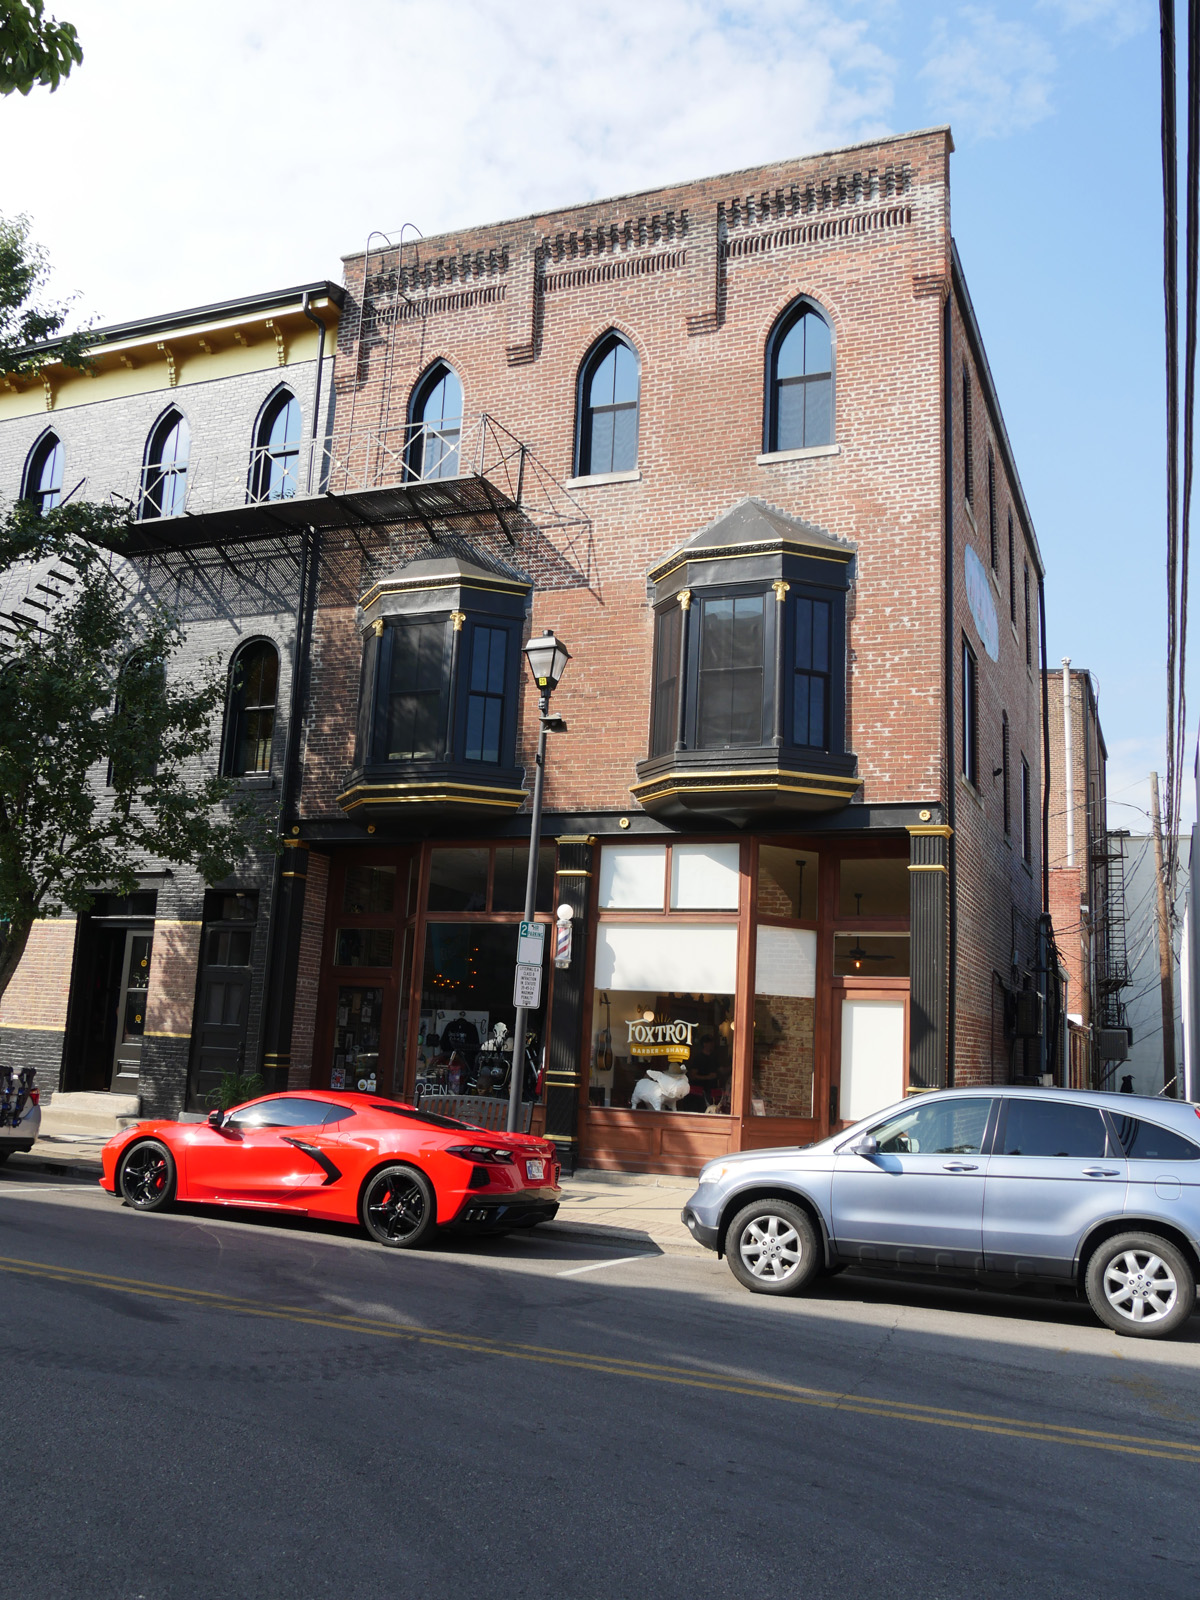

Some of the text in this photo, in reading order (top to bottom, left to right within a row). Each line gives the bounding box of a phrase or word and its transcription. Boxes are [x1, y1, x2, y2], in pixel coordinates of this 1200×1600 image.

[521, 924, 528, 935] 2
[625, 1019, 699, 1045] FOXTROT
[415, 1083, 448, 1096] OPEN
